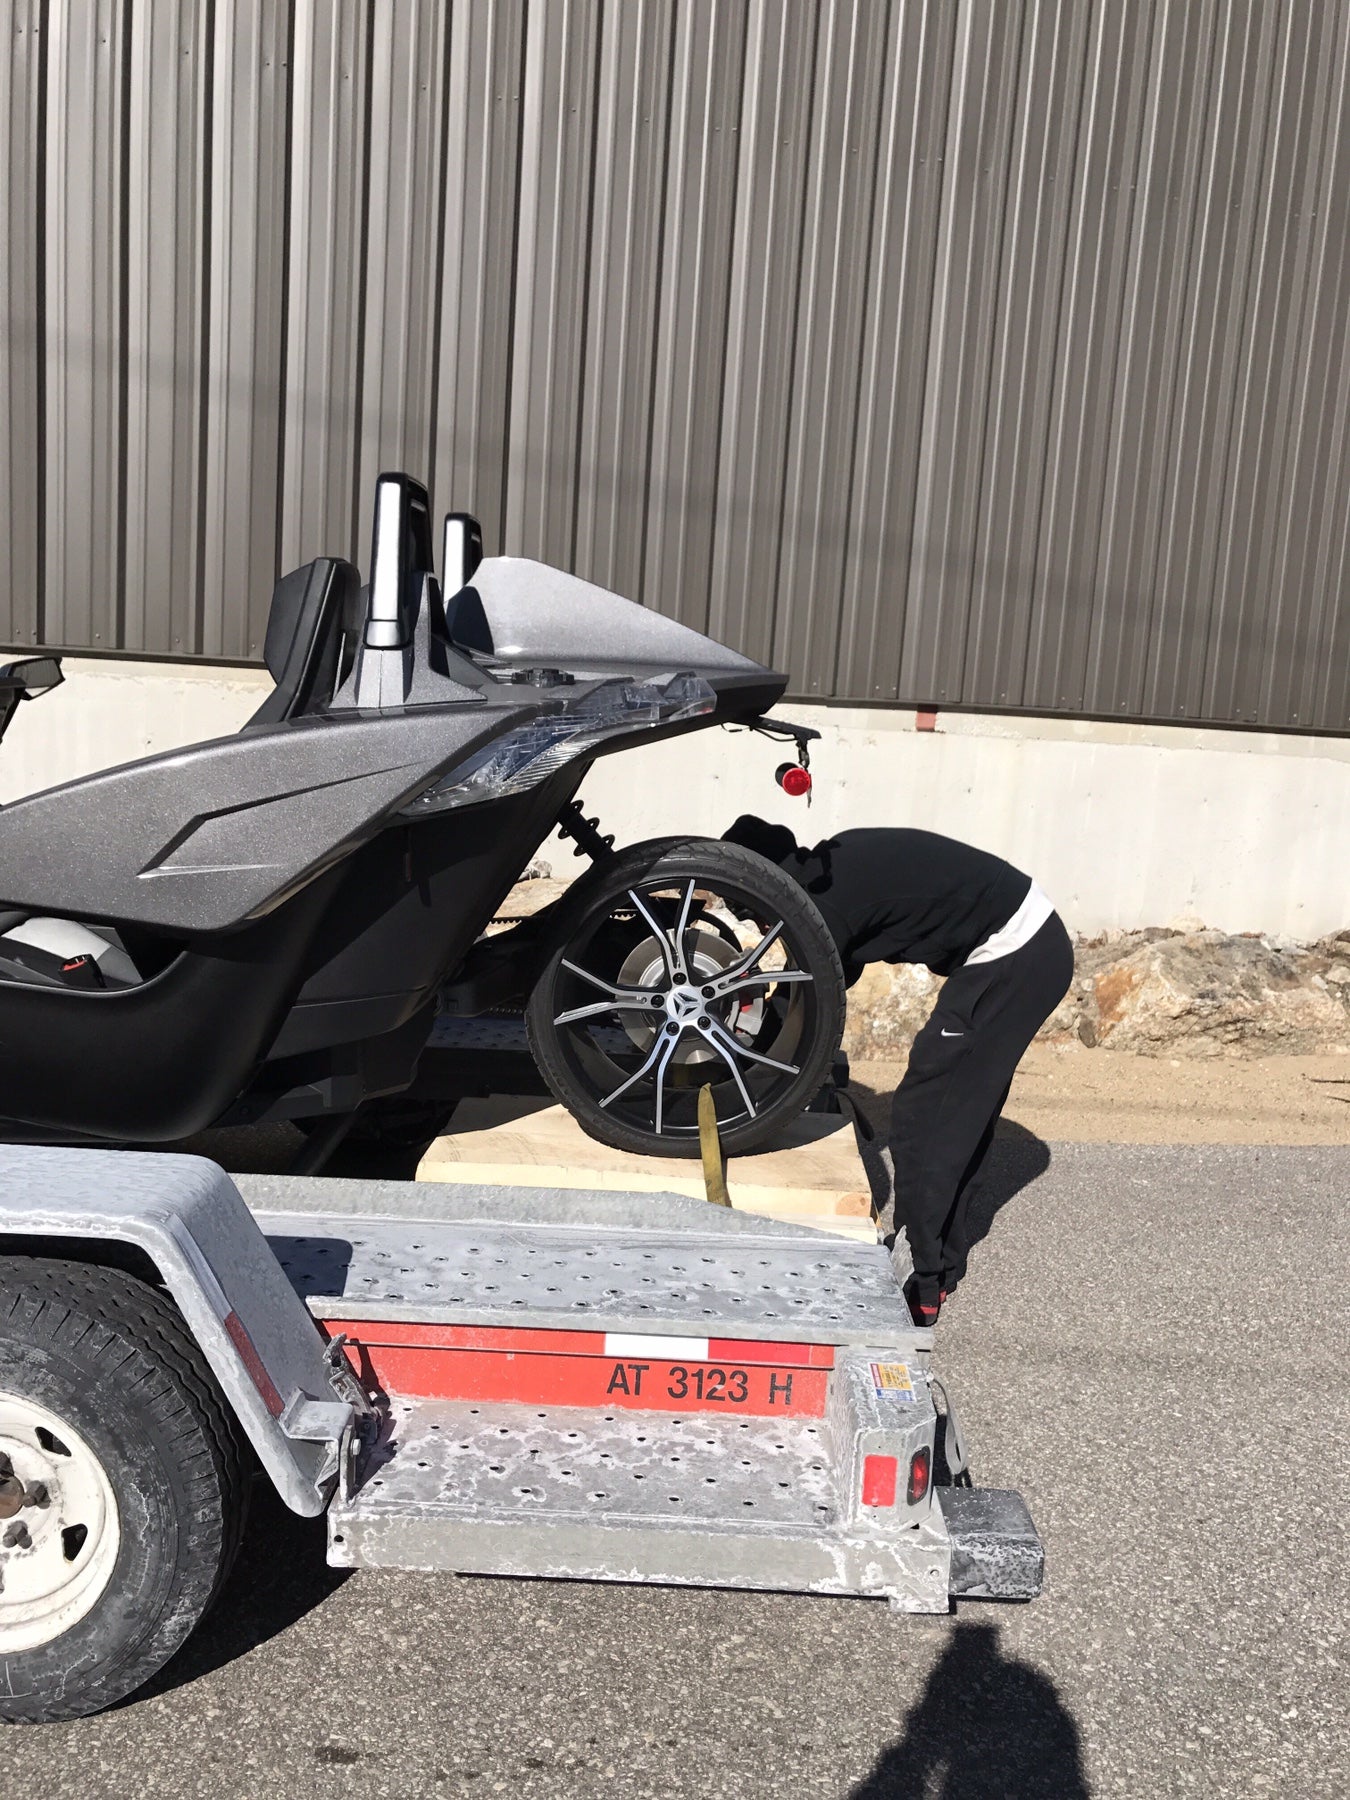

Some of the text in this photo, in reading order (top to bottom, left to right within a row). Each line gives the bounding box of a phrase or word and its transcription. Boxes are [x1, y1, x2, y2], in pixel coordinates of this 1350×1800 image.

[606, 1363, 793, 1405] AT 3123 H
